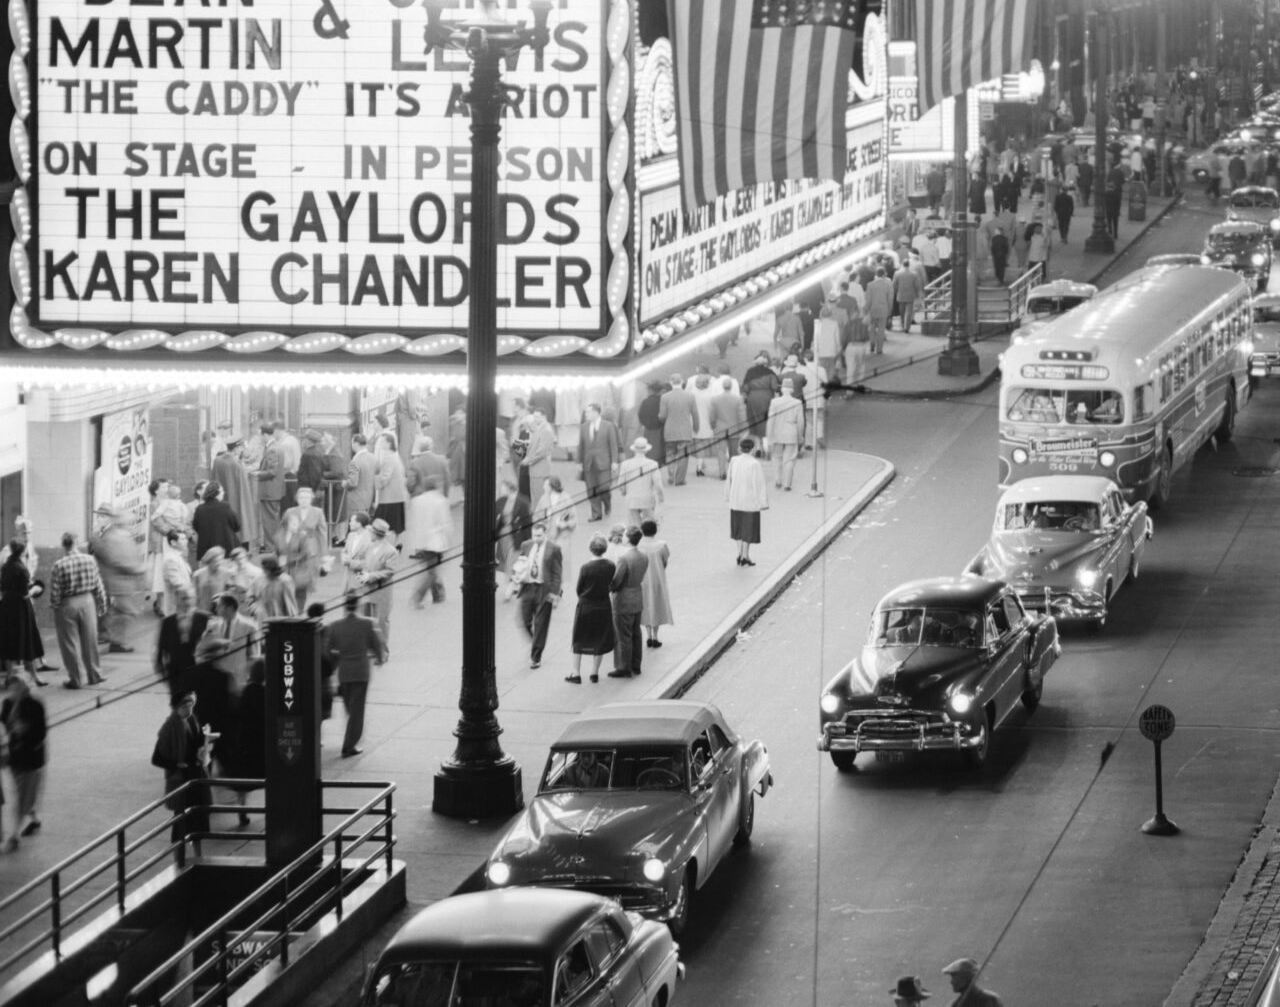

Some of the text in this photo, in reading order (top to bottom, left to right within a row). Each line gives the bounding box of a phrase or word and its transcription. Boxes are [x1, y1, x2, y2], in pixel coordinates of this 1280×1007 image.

[48, 17, 282, 70] MARTIN
[345, 81, 422, 118] IT'S
[445, 82, 475, 118] A
[498, 82, 597, 119] RIOT
[43, 141, 98, 177] ON
[123, 142, 258, 179] STAGE
[344, 145, 388, 181] IN
[415, 145, 594, 182] PESON
[65, 187, 186, 240] THE
[650, 207, 678, 251] DEAN
[44, 249, 593, 309] KAREN CHANDER
[645, 259, 661, 298] ON
[719, 218, 762, 263] GAYLORDS
[1036, 438, 1093, 452] Braumeister
[115, 467, 149, 498] GAYLORDS
[1049, 463, 1078, 472] 509
[283, 640, 295, 711] SUBWAY
[1144, 721, 1170, 734] ZONE
